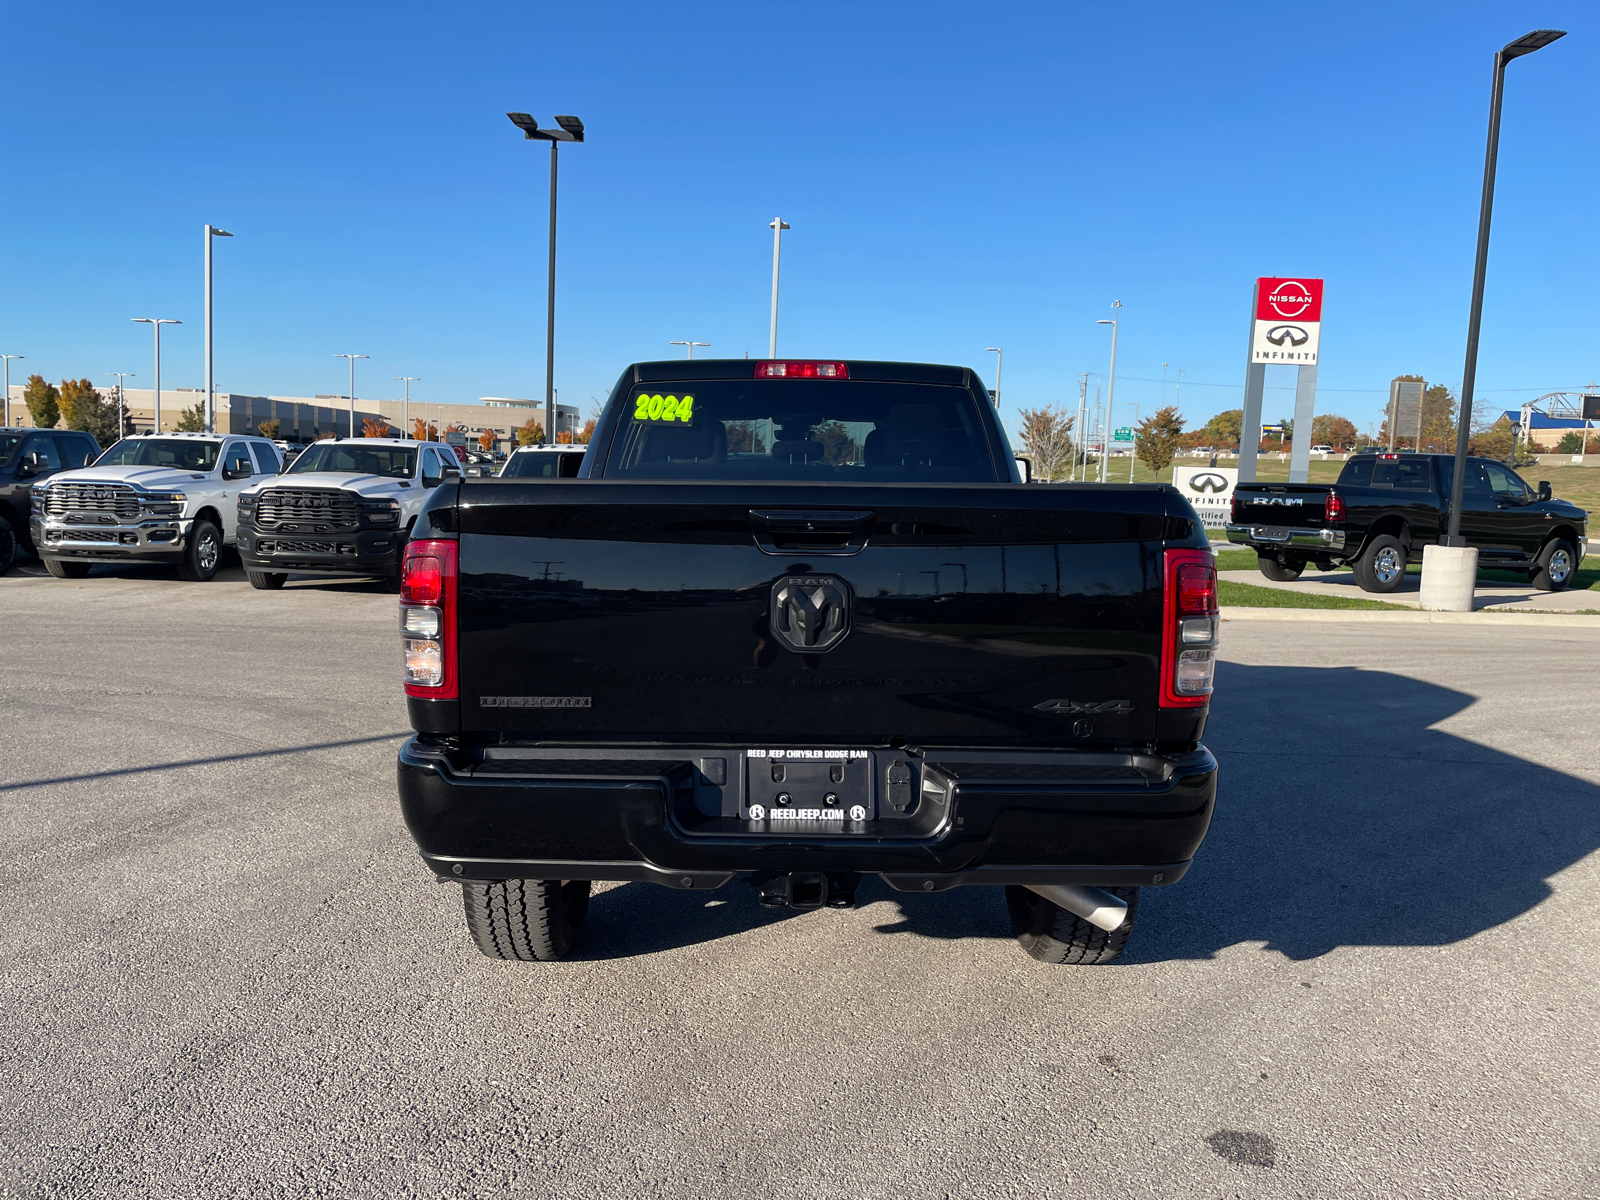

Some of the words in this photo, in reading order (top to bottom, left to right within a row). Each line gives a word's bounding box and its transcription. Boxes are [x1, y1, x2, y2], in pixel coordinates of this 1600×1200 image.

[1268, 295, 1312, 303] NISSAN
[1256, 351, 1316, 360] INFINITI
[634, 394, 694, 422] 2024
[281, 497, 330, 507] RAM
[1187, 497, 1232, 505] NFINIT
[1253, 496, 1303, 507] RAM
[1199, 511, 1224, 519] tified
[747, 750, 766, 758] REED
[768, 750, 785, 758] JEEP
[786, 750, 824, 759] CHRYSLER
[824, 750, 849, 759] DODGE
[850, 750, 868, 758] RAM
[770, 808, 844, 820] REEDJEEP.COM
